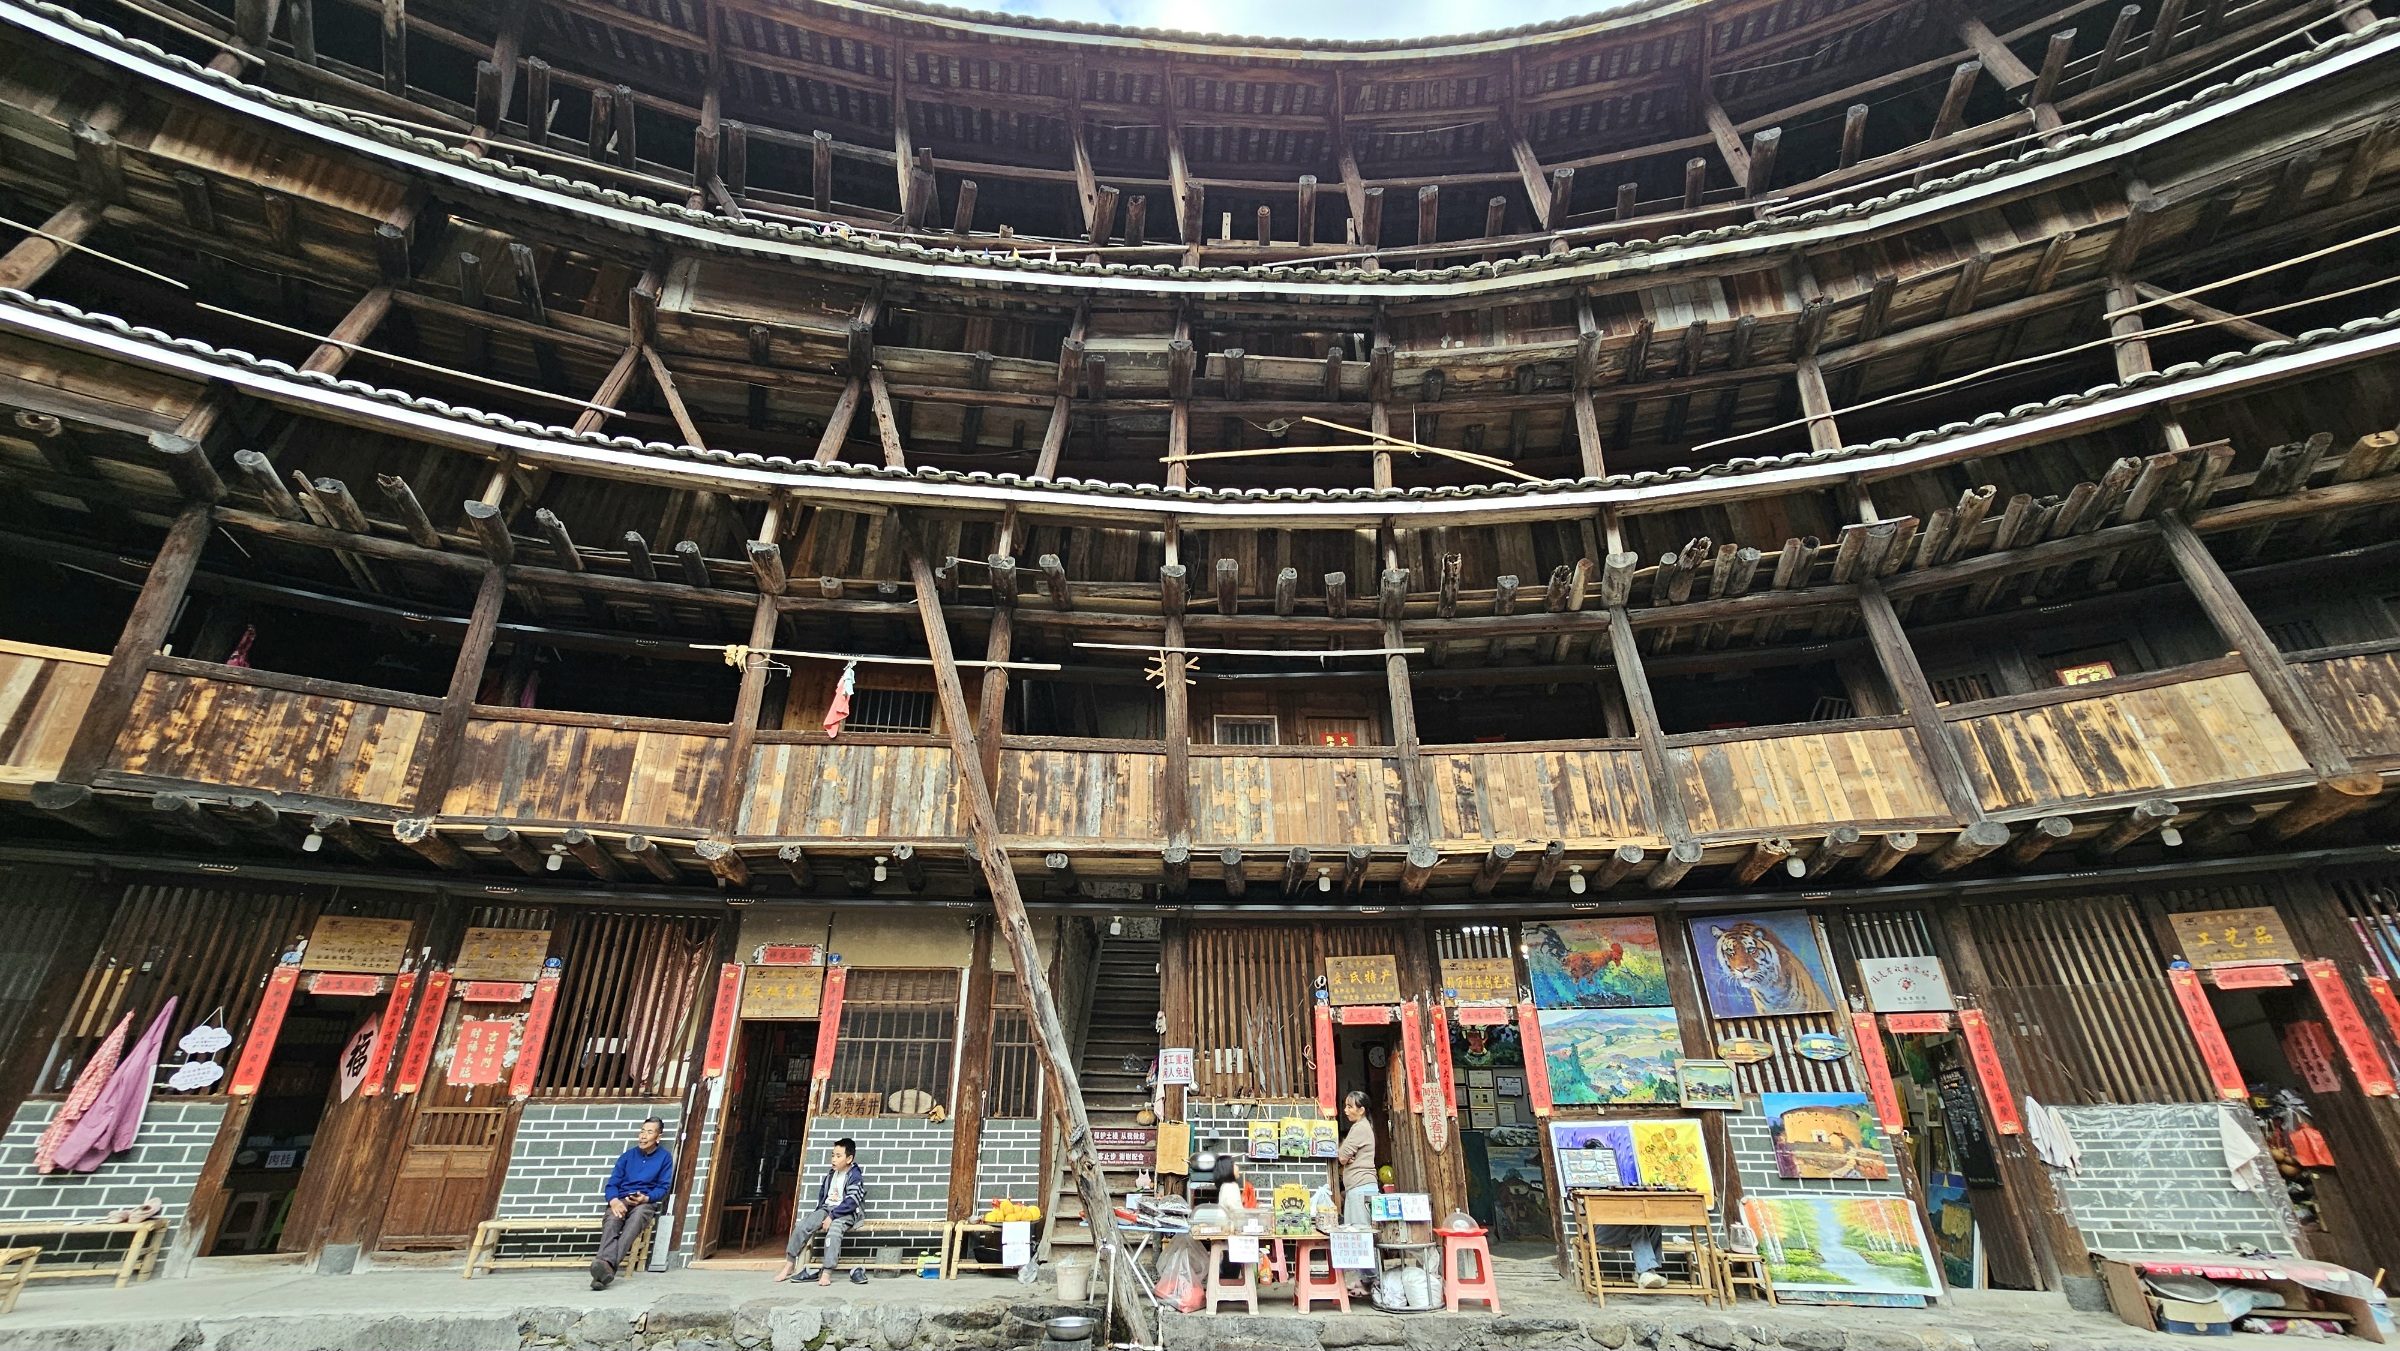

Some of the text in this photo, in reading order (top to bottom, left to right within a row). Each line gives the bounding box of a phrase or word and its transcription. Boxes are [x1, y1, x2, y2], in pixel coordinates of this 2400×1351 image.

[2197, 926, 2274, 948] 工艺品
[346, 1030, 374, 1078] 福
[459, 1027, 483, 1079] 財福永臨
[480, 1030, 500, 1075] 吉祥門
[829, 1097, 879, 1116] 免费看井
[1427, 1096, 1444, 1147] 免费看井
[1094, 1131, 1145, 1140] 保护土楼 从我做起
[268, 1154, 293, 1165] 肉桂
[1097, 1152, 1144, 1161] 客止步 谢谢配合
